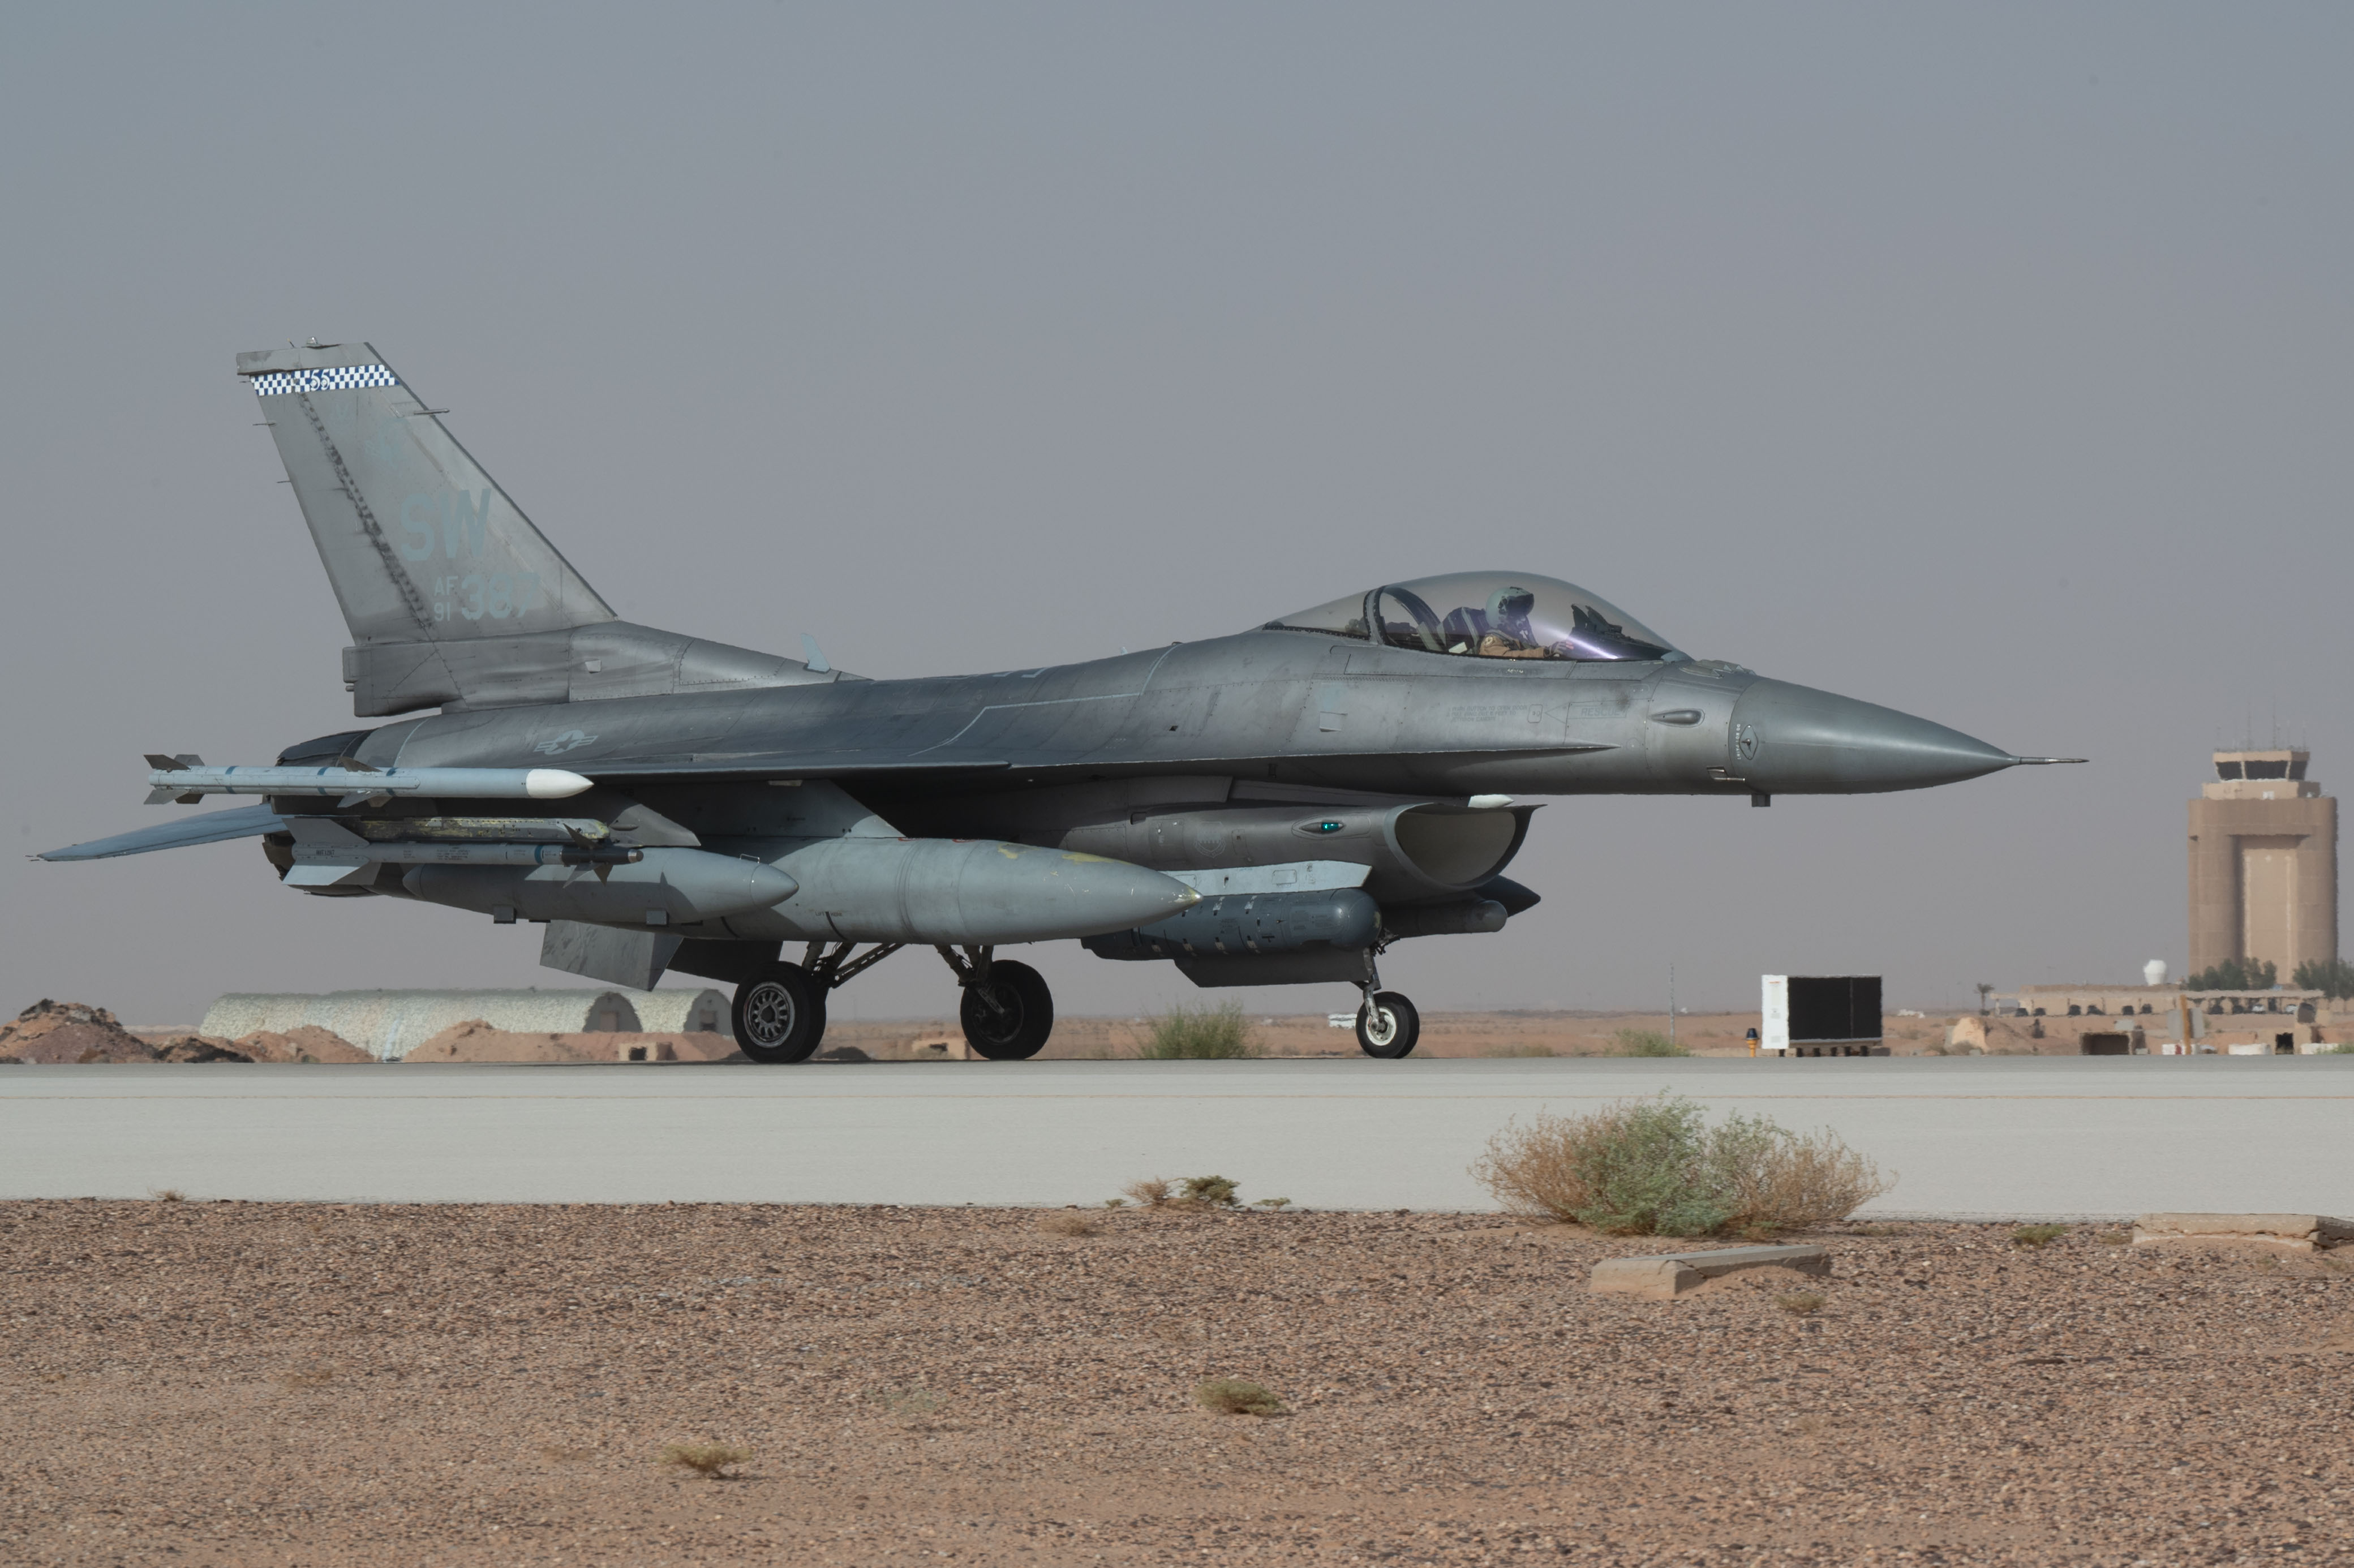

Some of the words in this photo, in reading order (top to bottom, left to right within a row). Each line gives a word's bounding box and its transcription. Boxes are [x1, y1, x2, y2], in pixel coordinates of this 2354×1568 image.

[310, 368, 330, 392] 55
[401, 488, 492, 561] SW
[434, 575, 458, 597] AF
[461, 572, 540, 621] 387
[433, 602, 451, 622] 91
[1580, 706, 1622, 717] RESCUE
